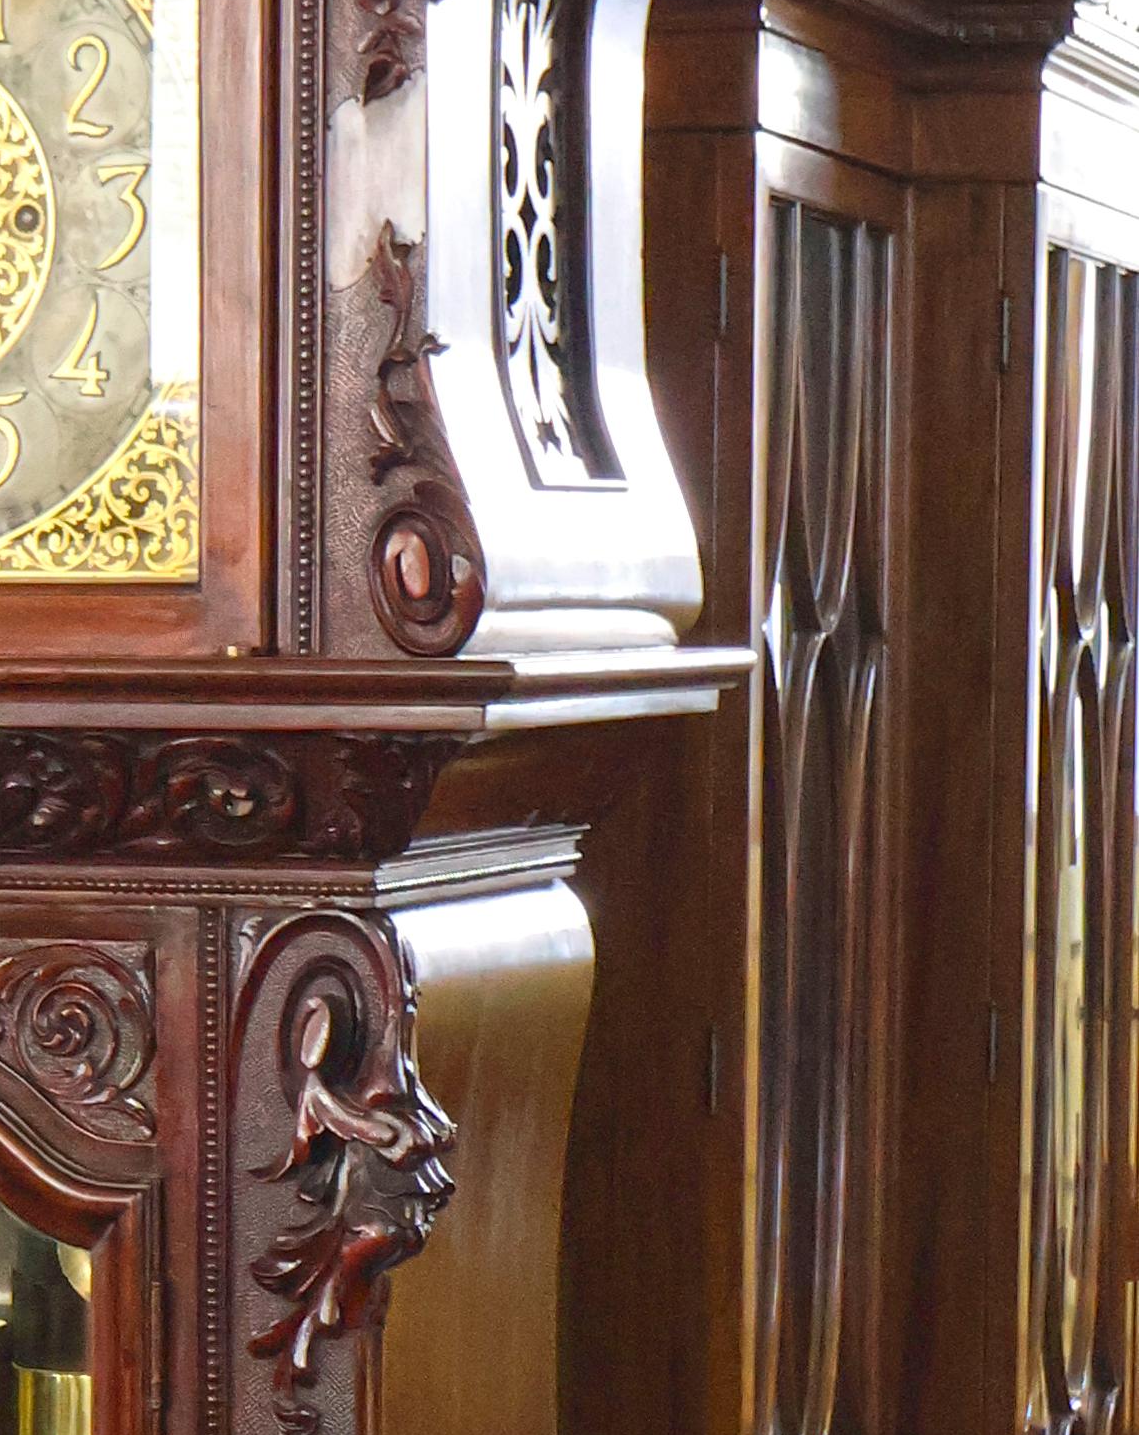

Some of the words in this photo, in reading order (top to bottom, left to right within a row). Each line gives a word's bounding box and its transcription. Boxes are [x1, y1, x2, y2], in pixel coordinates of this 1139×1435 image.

[65, 34, 113, 138] 2
[95, 163, 151, 271] 3
[47, 296, 110, 398] 4
